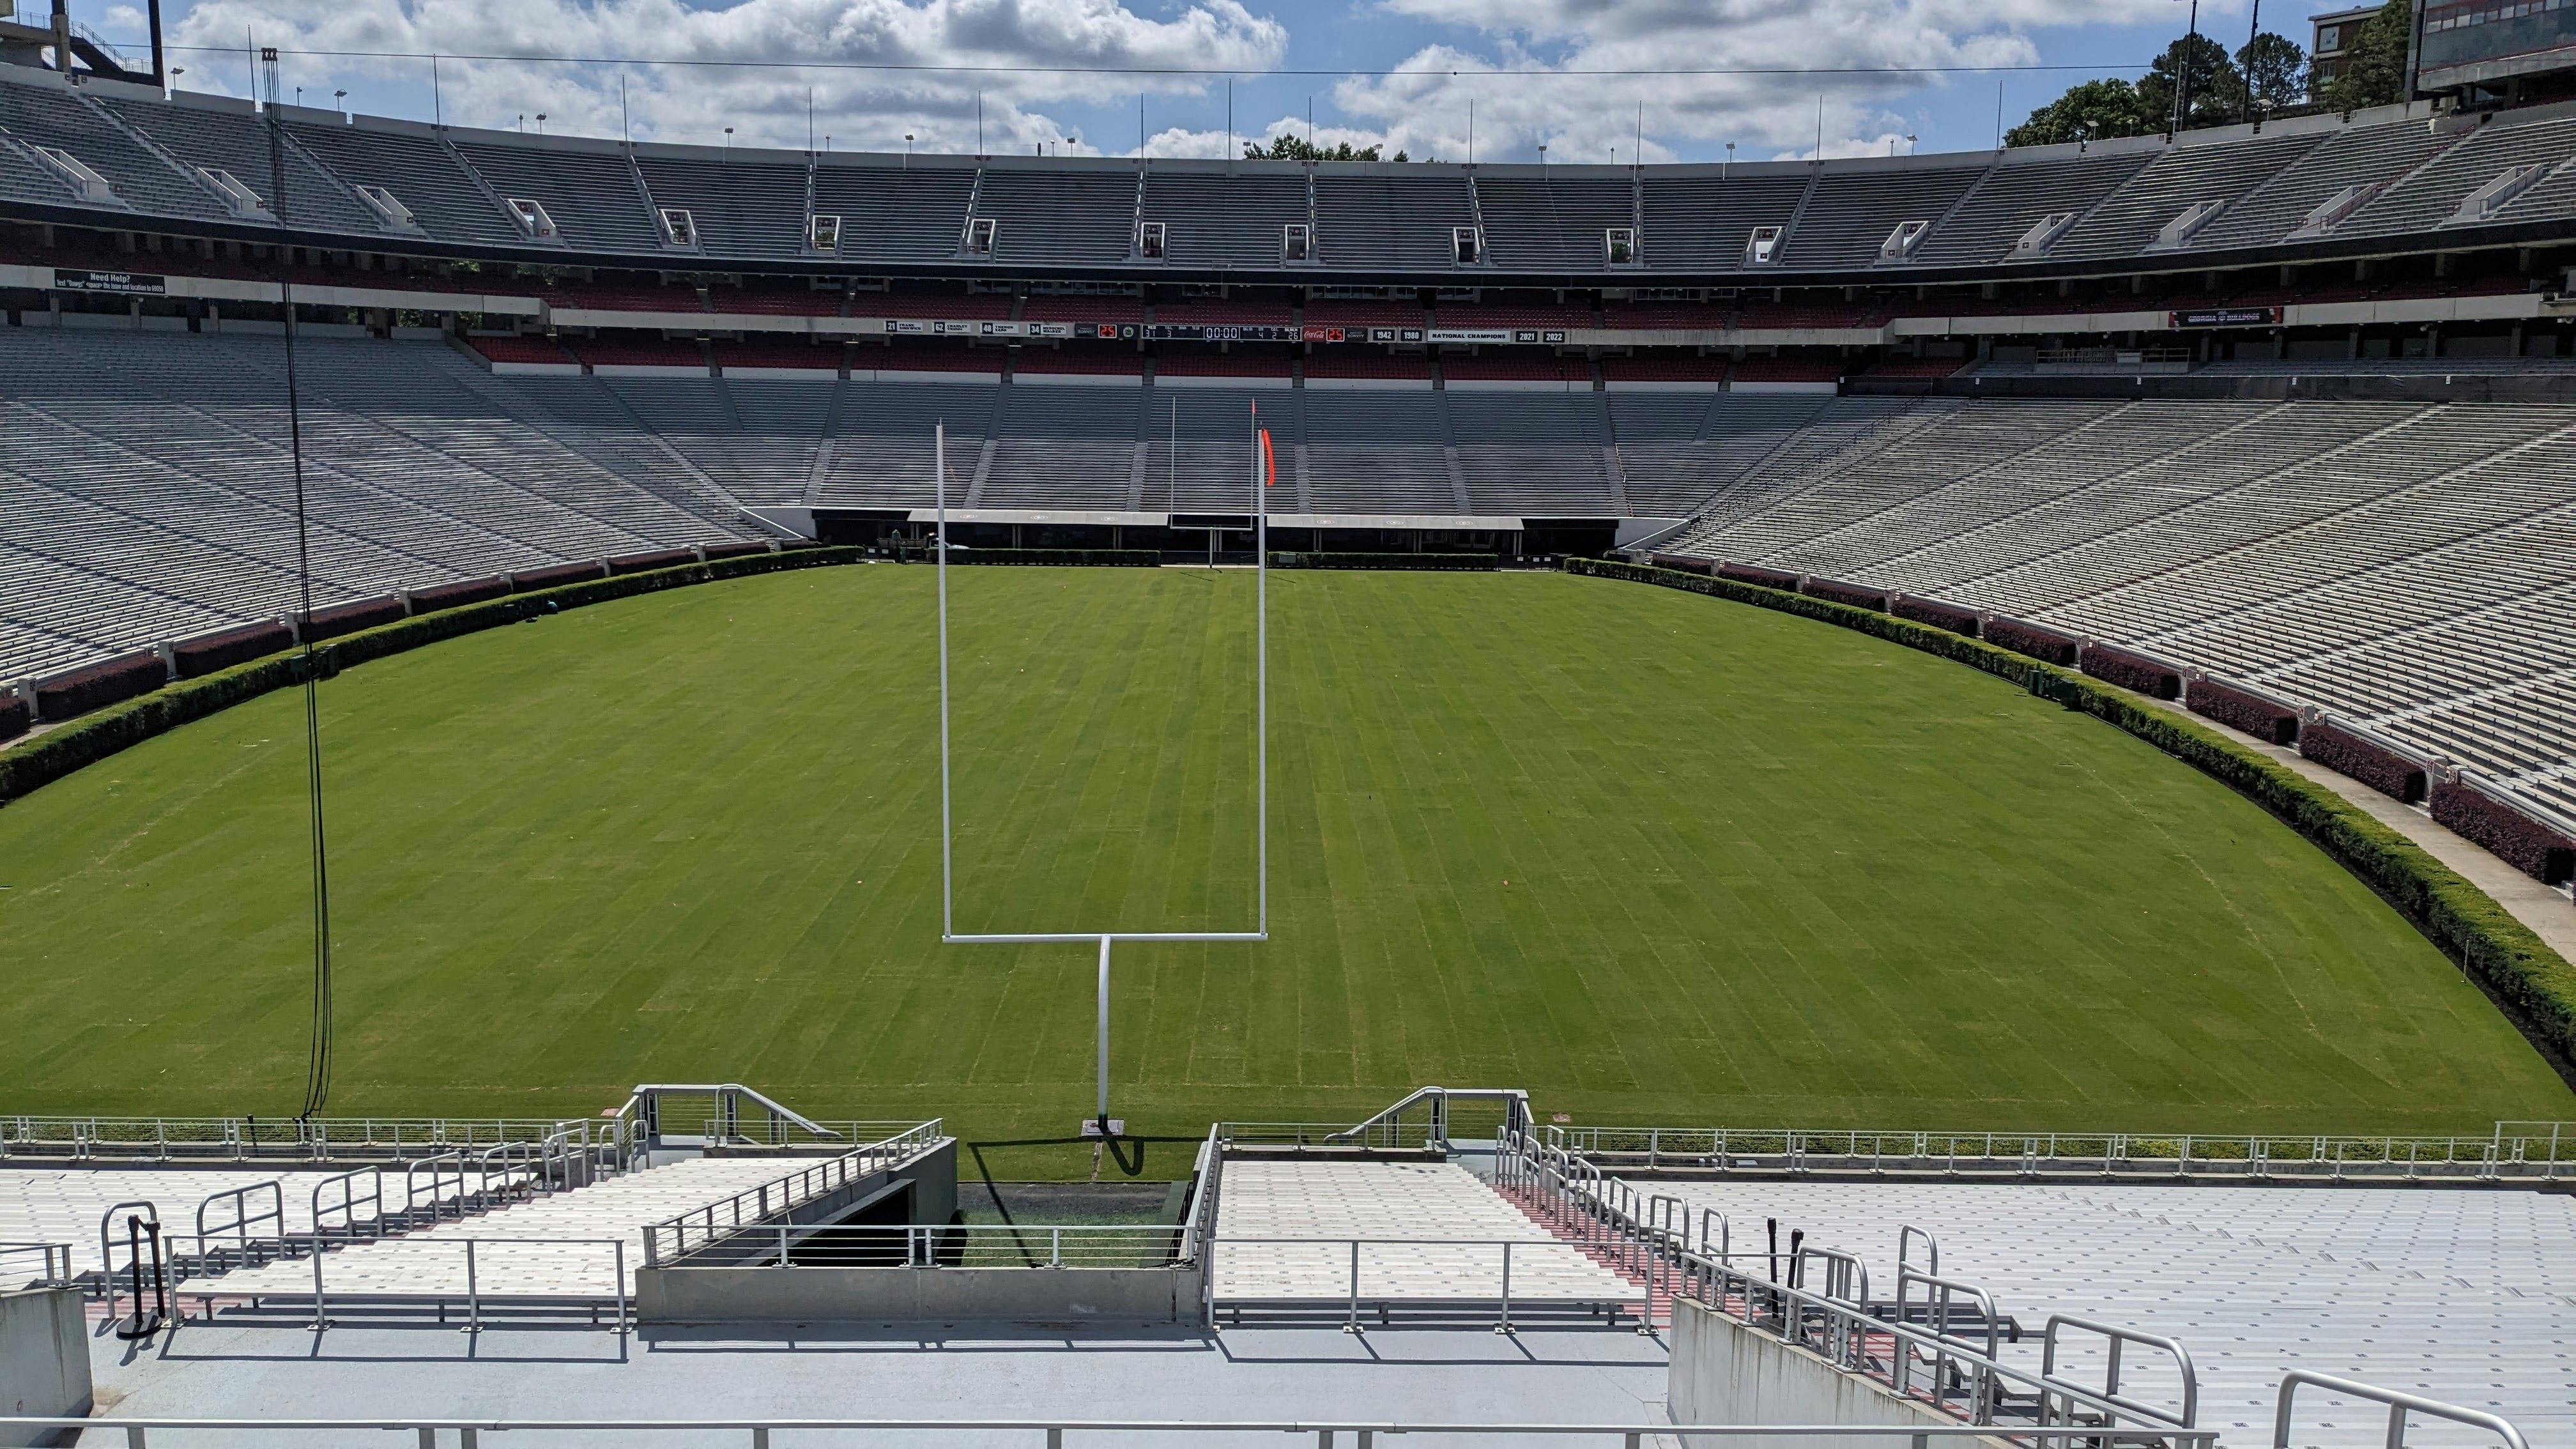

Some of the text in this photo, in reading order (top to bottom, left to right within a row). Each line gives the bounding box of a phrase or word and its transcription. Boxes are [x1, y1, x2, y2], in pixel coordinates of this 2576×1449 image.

[90, 273, 130, 284] Need Help?
[887, 322, 894, 330] 21
[983, 324, 992, 332] 40
[1031, 325, 1039, 334] 34
[1101, 325, 1114, 337] 25
[1206, 327, 1238, 339] 00:00
[1328, 330, 1342, 340] 25
[1377, 331, 1392, 339] 1942
[1404, 331, 1420, 339] 1980
[1288, 332, 1298, 341] 26
[1519, 332, 1535, 341] 2021
[1546, 333, 1562, 341] 2022
